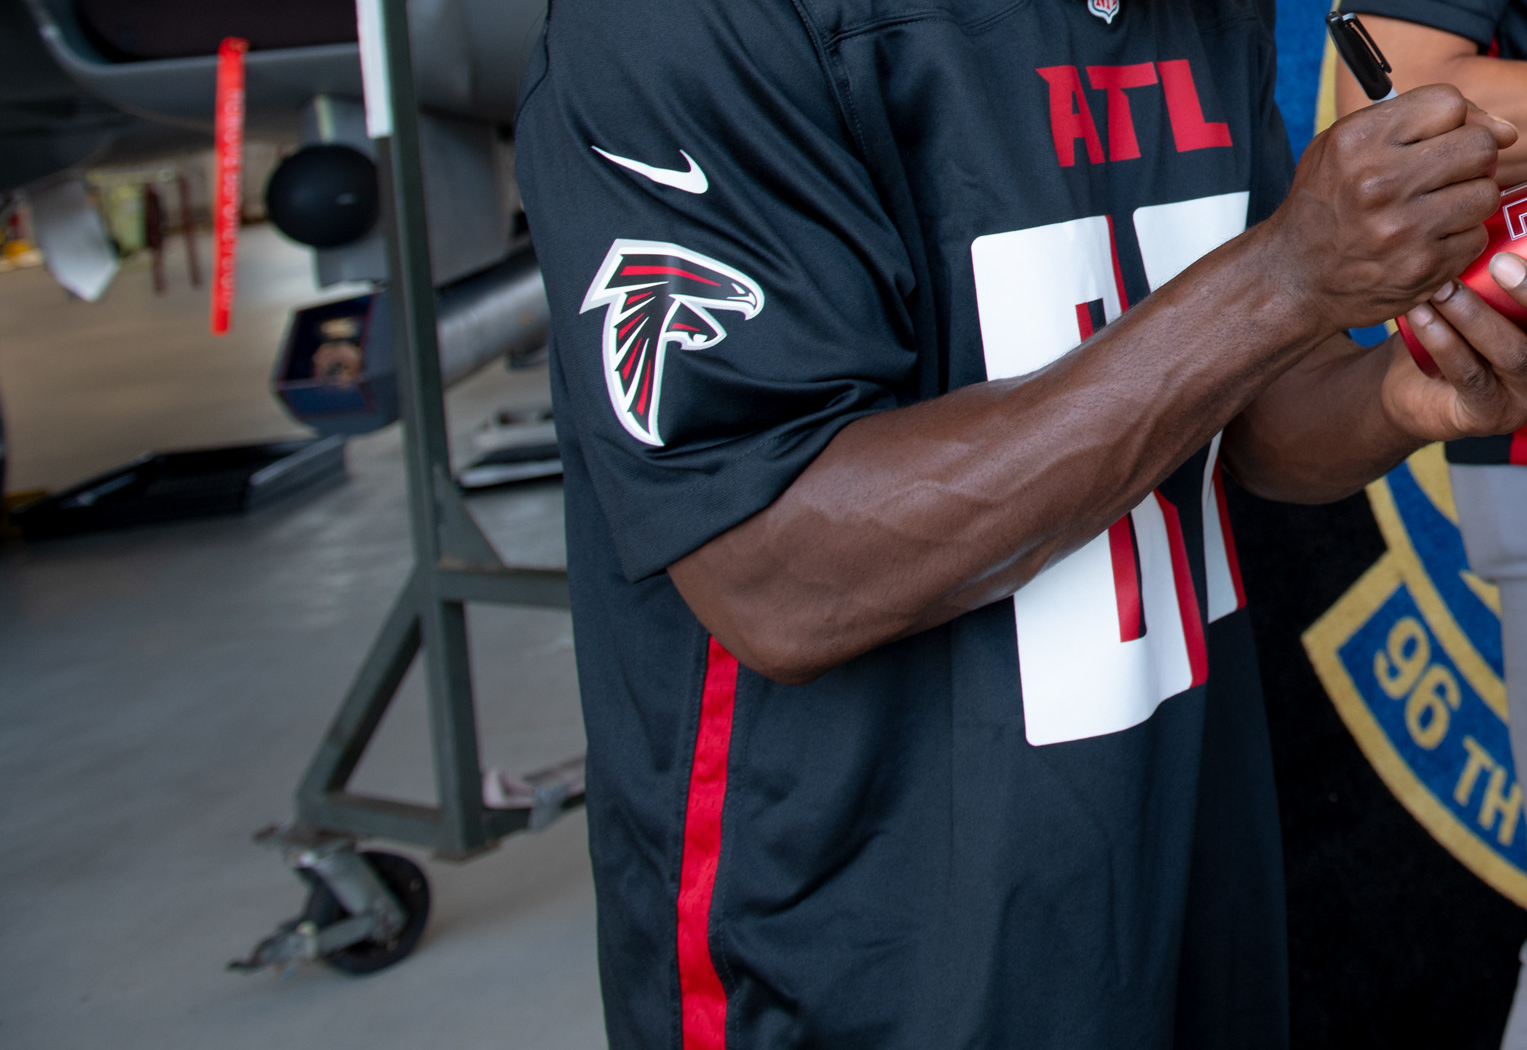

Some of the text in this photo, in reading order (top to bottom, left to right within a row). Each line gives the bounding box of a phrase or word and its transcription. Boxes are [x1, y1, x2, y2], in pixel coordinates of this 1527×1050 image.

[1035, 58, 1233, 168] ATL
[1373, 615, 1462, 751] 96
[1453, 734, 1523, 847] TH
